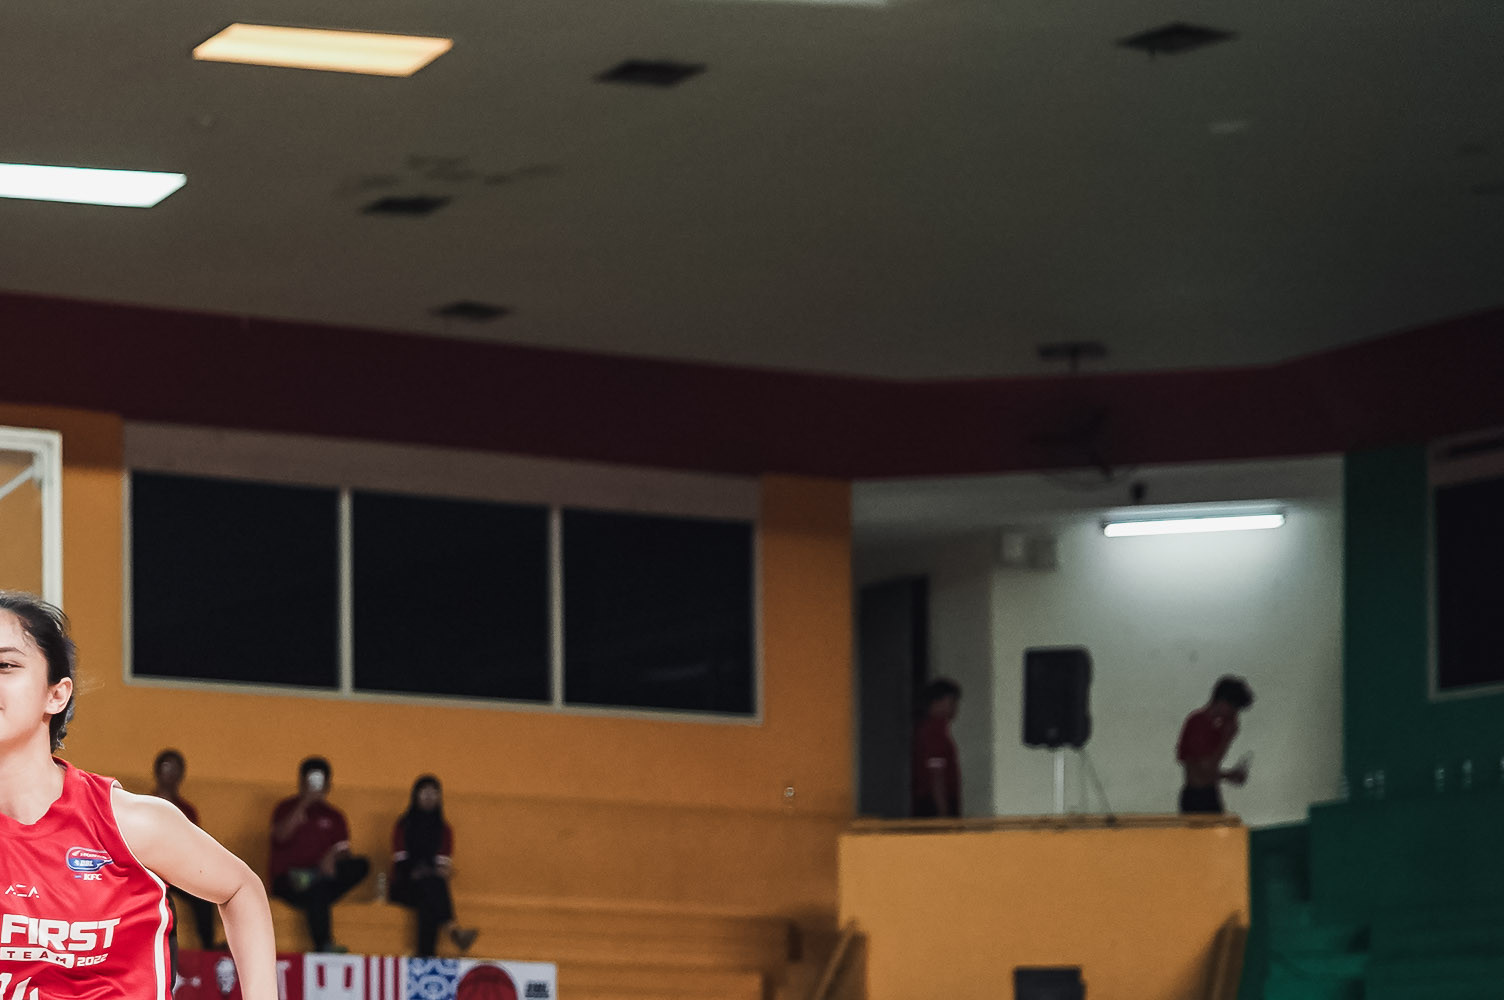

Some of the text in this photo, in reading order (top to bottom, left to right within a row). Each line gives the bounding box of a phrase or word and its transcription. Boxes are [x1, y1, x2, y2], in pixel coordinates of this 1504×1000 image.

[0, 913, 121, 951] FIRST
[6, 950, 109, 967] TEAM 2022
